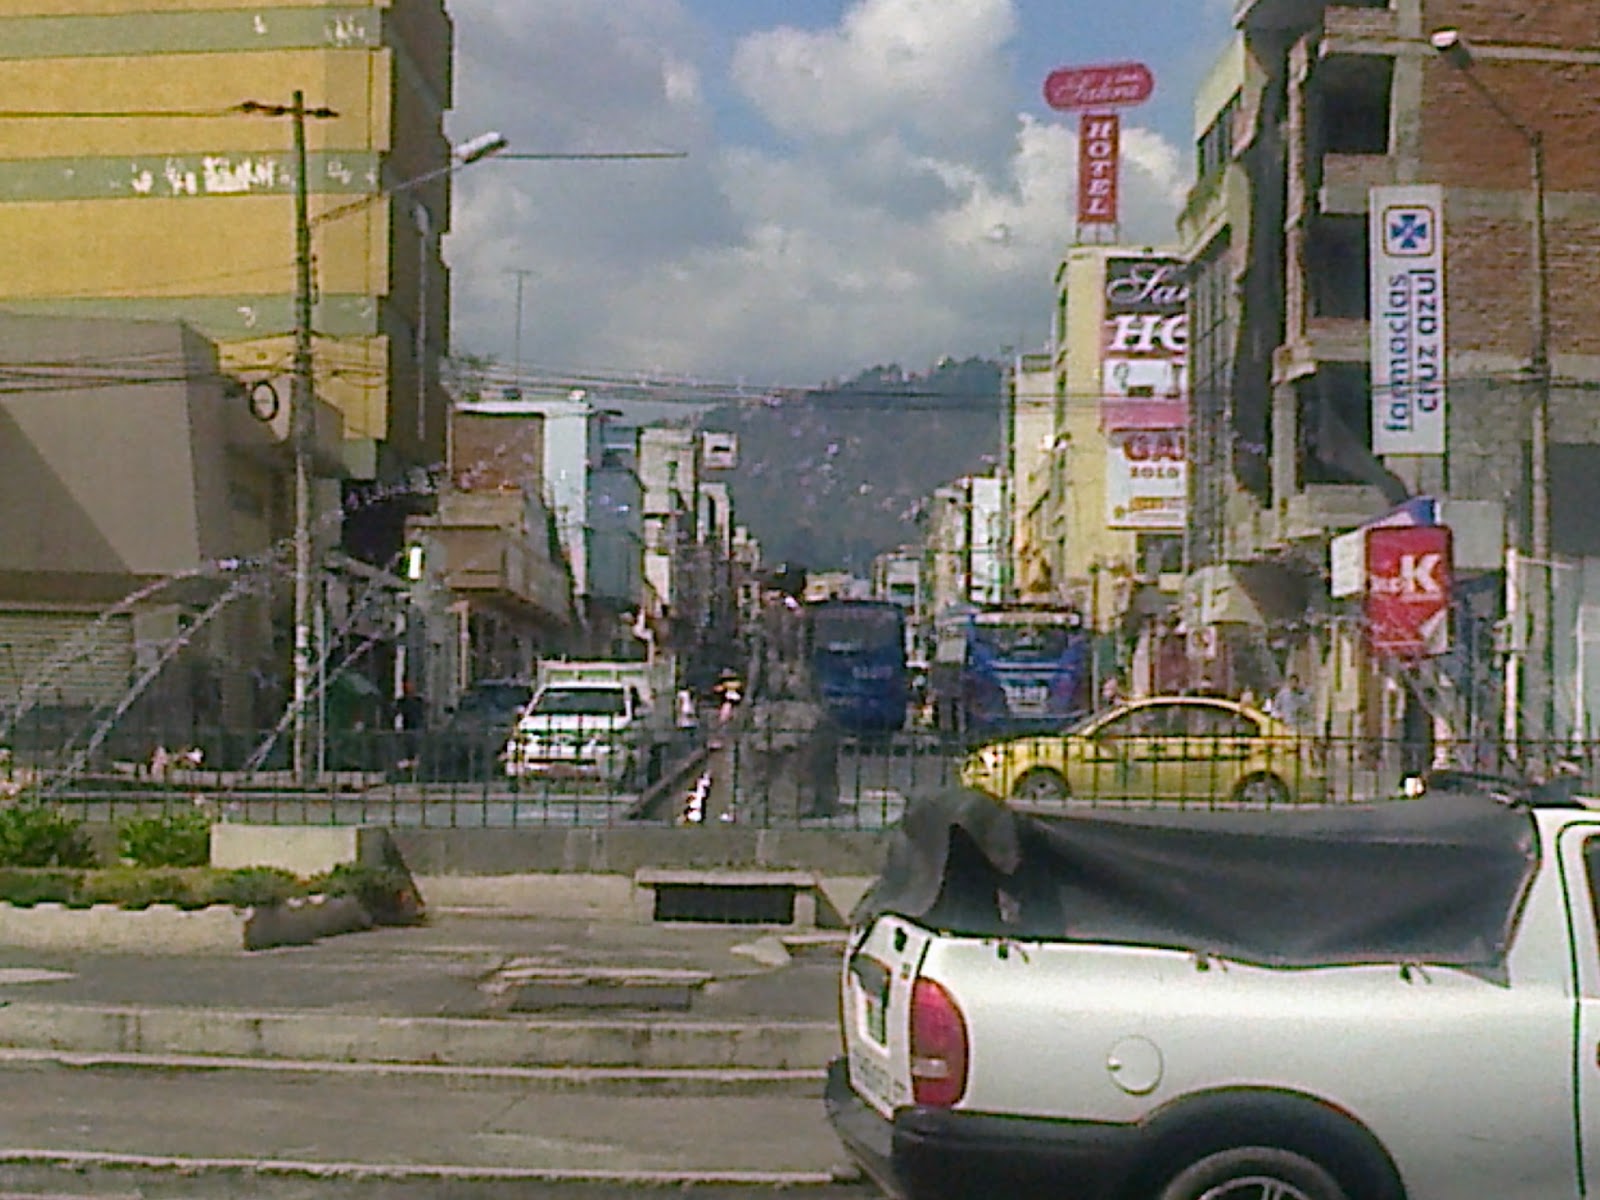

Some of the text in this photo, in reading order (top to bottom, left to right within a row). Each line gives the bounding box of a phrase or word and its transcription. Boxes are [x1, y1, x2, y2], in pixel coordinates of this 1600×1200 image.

[1087, 122, 1112, 214] HOTEL
[1383, 274, 1408, 431] farmacias
[1408, 268, 1438, 412] cruz azul
